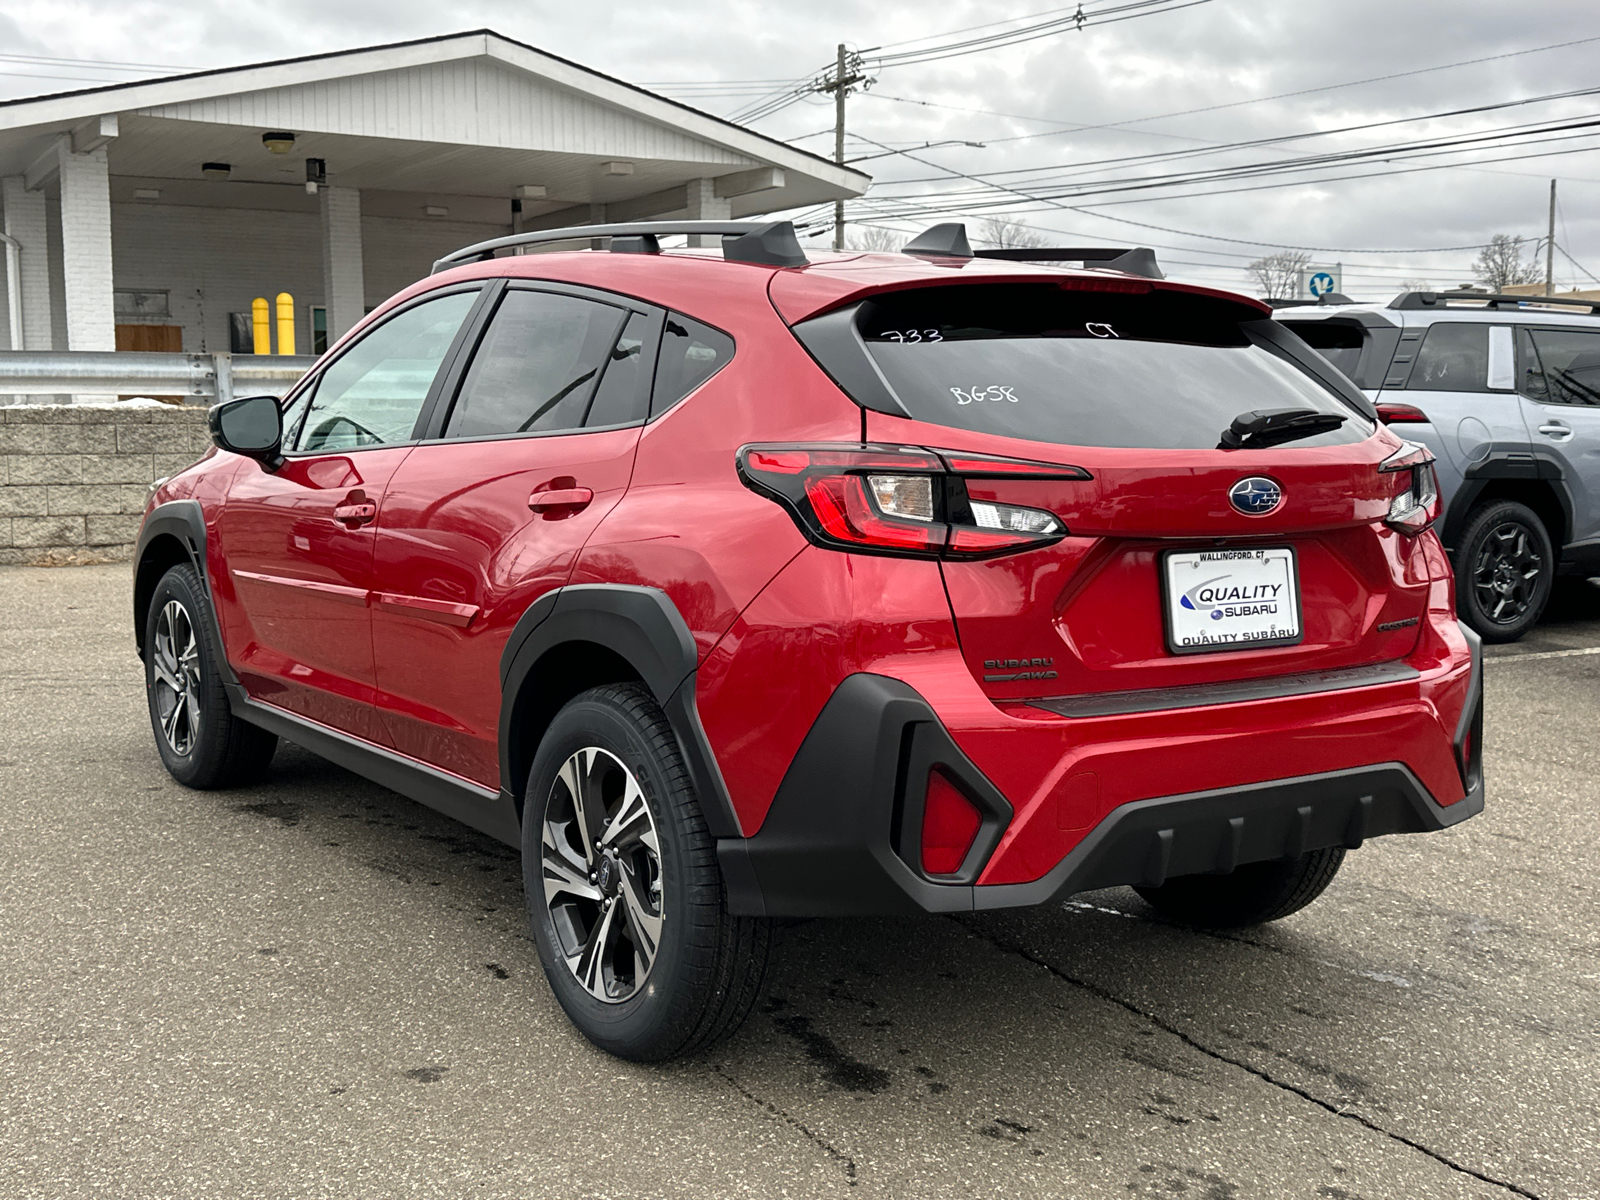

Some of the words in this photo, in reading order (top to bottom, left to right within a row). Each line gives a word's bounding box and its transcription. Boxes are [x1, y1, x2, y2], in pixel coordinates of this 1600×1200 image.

[880, 329, 944, 345] 733
[1085, 322, 1120, 338] CT
[1256, 551, 1265, 559] CT
[1200, 584, 1282, 603] QUALITY
[1225, 604, 1278, 617] SUBARU
[1182, 633, 1238, 646] QUALITY
[1242, 628, 1295, 641] SUBARU
[984, 657, 1053, 669] SUBARU
[1012, 670, 1058, 680] AWD
